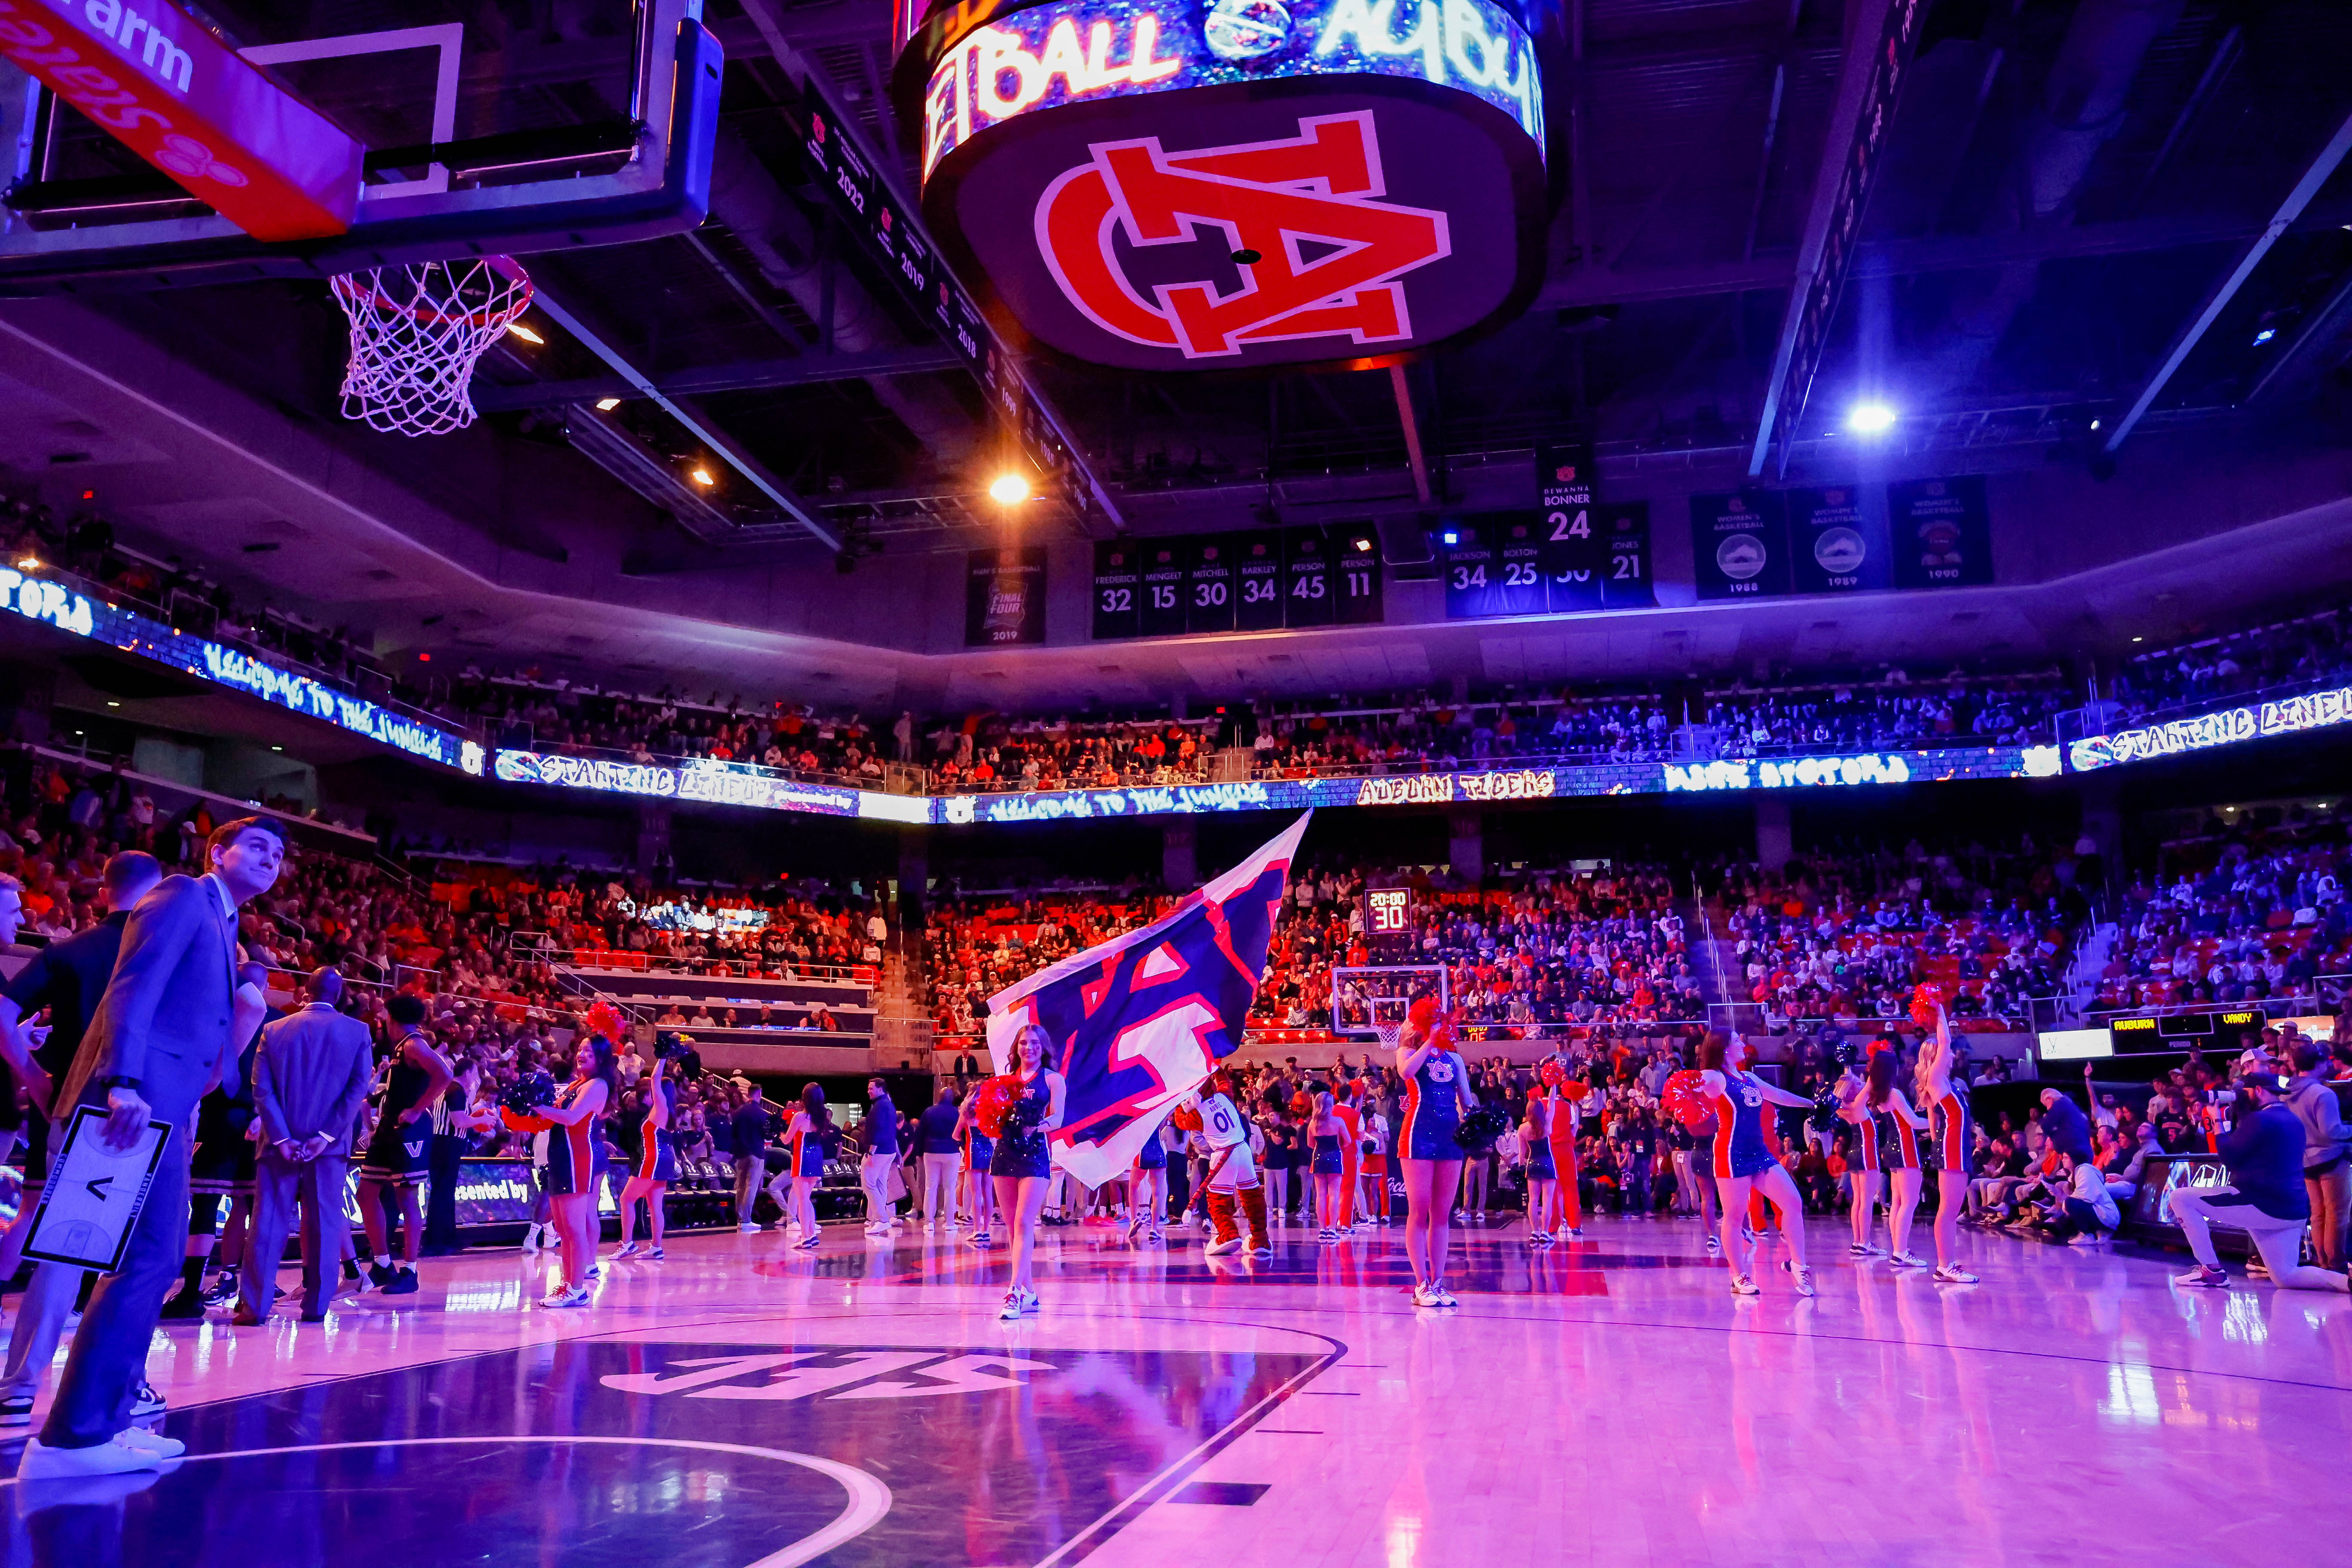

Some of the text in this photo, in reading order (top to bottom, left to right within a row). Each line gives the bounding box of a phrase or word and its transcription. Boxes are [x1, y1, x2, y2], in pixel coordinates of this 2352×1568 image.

[62, 0, 193, 93] arm
[1316, 0, 1545, 155] AUBU
[838, 166, 864, 214] 2022
[902, 252, 924, 291] 2019
[958, 323, 976, 358] 2018
[1544, 485, 1590, 494] DEWANNA
[1544, 494, 1590, 506] BONNER
[1548, 510, 1590, 541] 24
[1341, 559, 1375, 568] PERSON
[1504, 548, 1537, 557] BOLTON
[1145, 571, 1182, 581] MENGELT
[1193, 568, 1229, 578] MITCHELL
[1242, 565, 1277, 575] BARKLEY
[1292, 562, 1326, 572] PERSON
[1453, 564, 1487, 589] 34
[1505, 563, 1537, 585] 25
[1612, 554, 1640, 579] 21
[1929, 568, 1959, 579] 1990
[1096, 575, 1138, 584] FREDERICK
[1244, 579, 1276, 602] 34
[1292, 575, 1325, 599] 45
[1348, 572, 1370, 597] 11
[1730, 582, 1759, 593] 1988
[1101, 588, 1131, 612] 32
[1152, 585, 1176, 608] 15
[1195, 582, 1227, 606] 30
[992, 631, 1018, 640] 2019
[1357, 769, 1556, 805] AUBURN TIGERS
[1370, 892, 1406, 907] 20:00
[1375, 906, 1403, 929] 30
[2114, 1019, 2155, 1030] AUBURN
[2222, 1013, 2252, 1024] VANDY
[1213, 1108, 1235, 1133] 01
[404, 1140, 423, 1158] V
[86, 1176, 114, 1202] V
[509, 1179, 528, 1203] by
